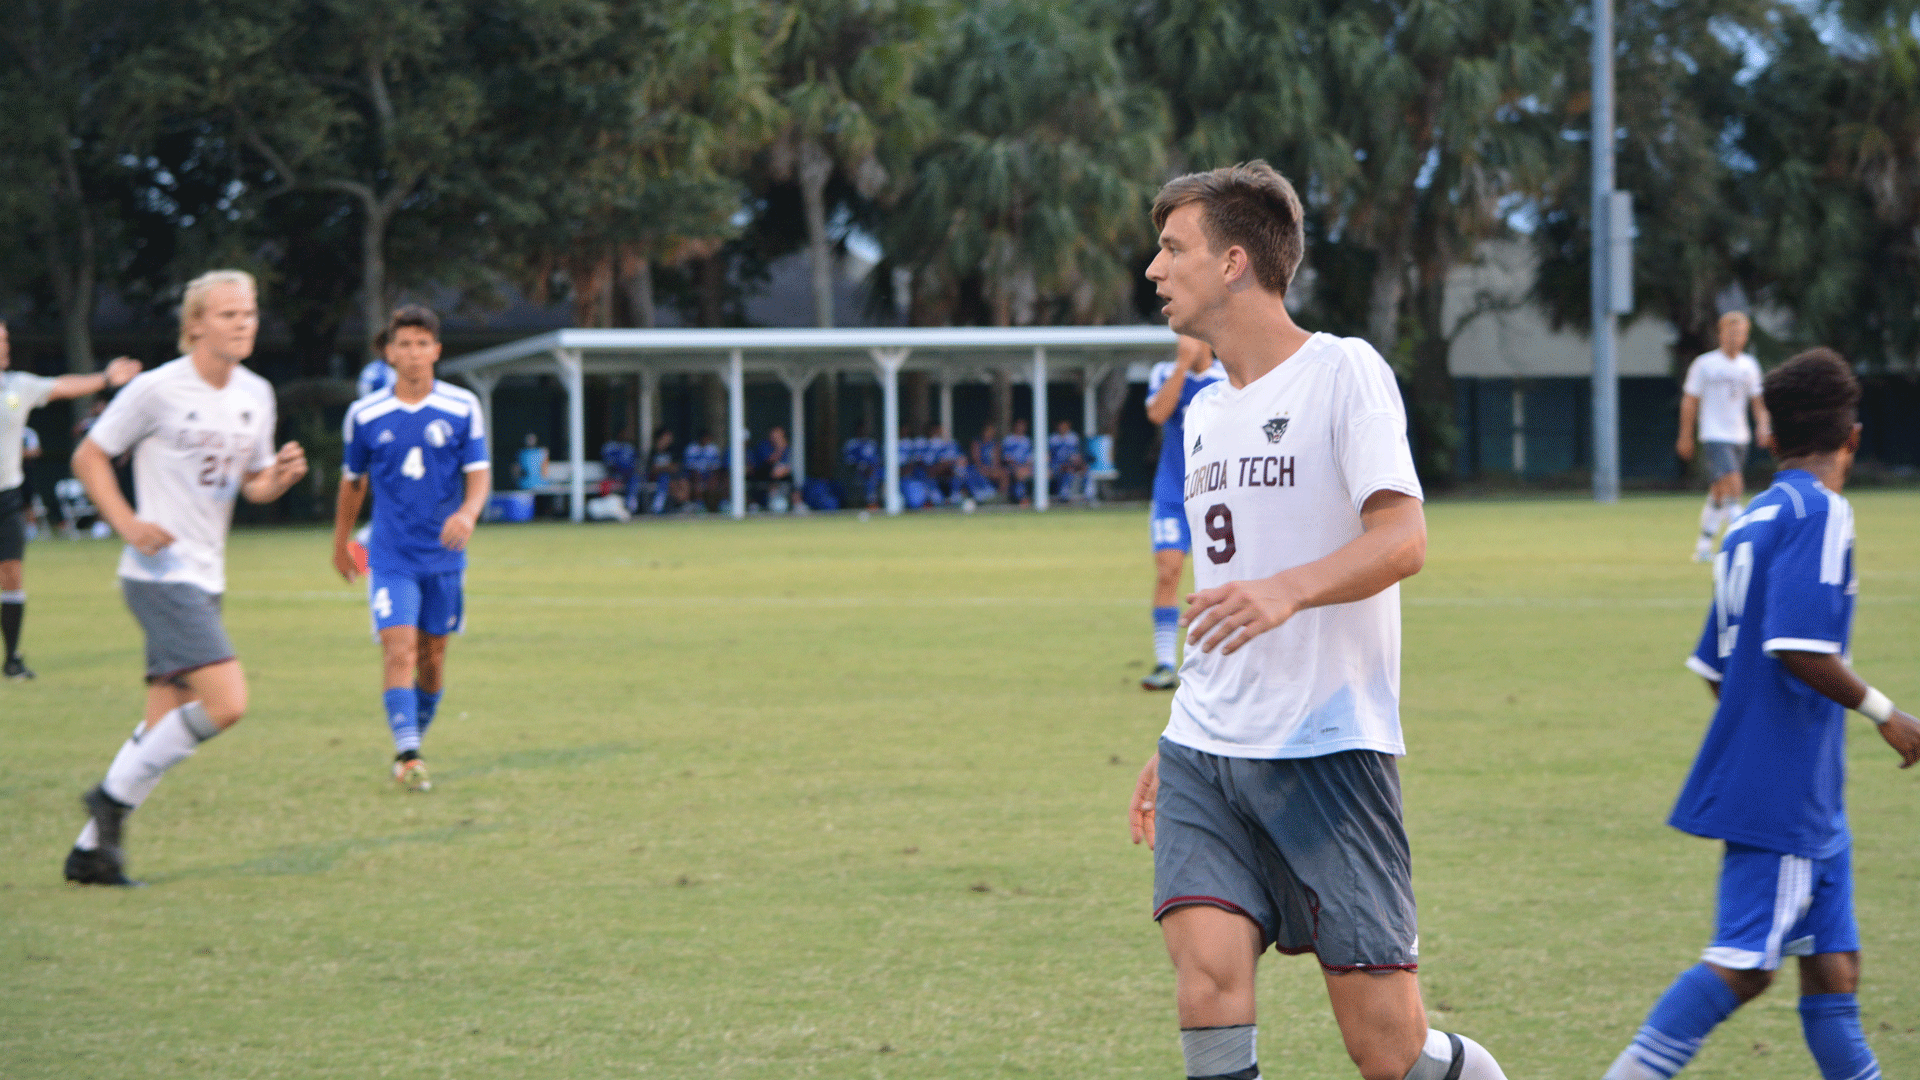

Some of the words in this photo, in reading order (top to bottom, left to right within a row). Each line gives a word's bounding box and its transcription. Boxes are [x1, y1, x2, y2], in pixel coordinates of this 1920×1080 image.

[401, 445, 426, 481] 4
[1183, 459, 1227, 503] LORIDA
[1238, 455, 1295, 487] TECH
[1153, 516, 1181, 543] 15
[1204, 502, 1237, 565] 9
[374, 586, 393, 619] 4
